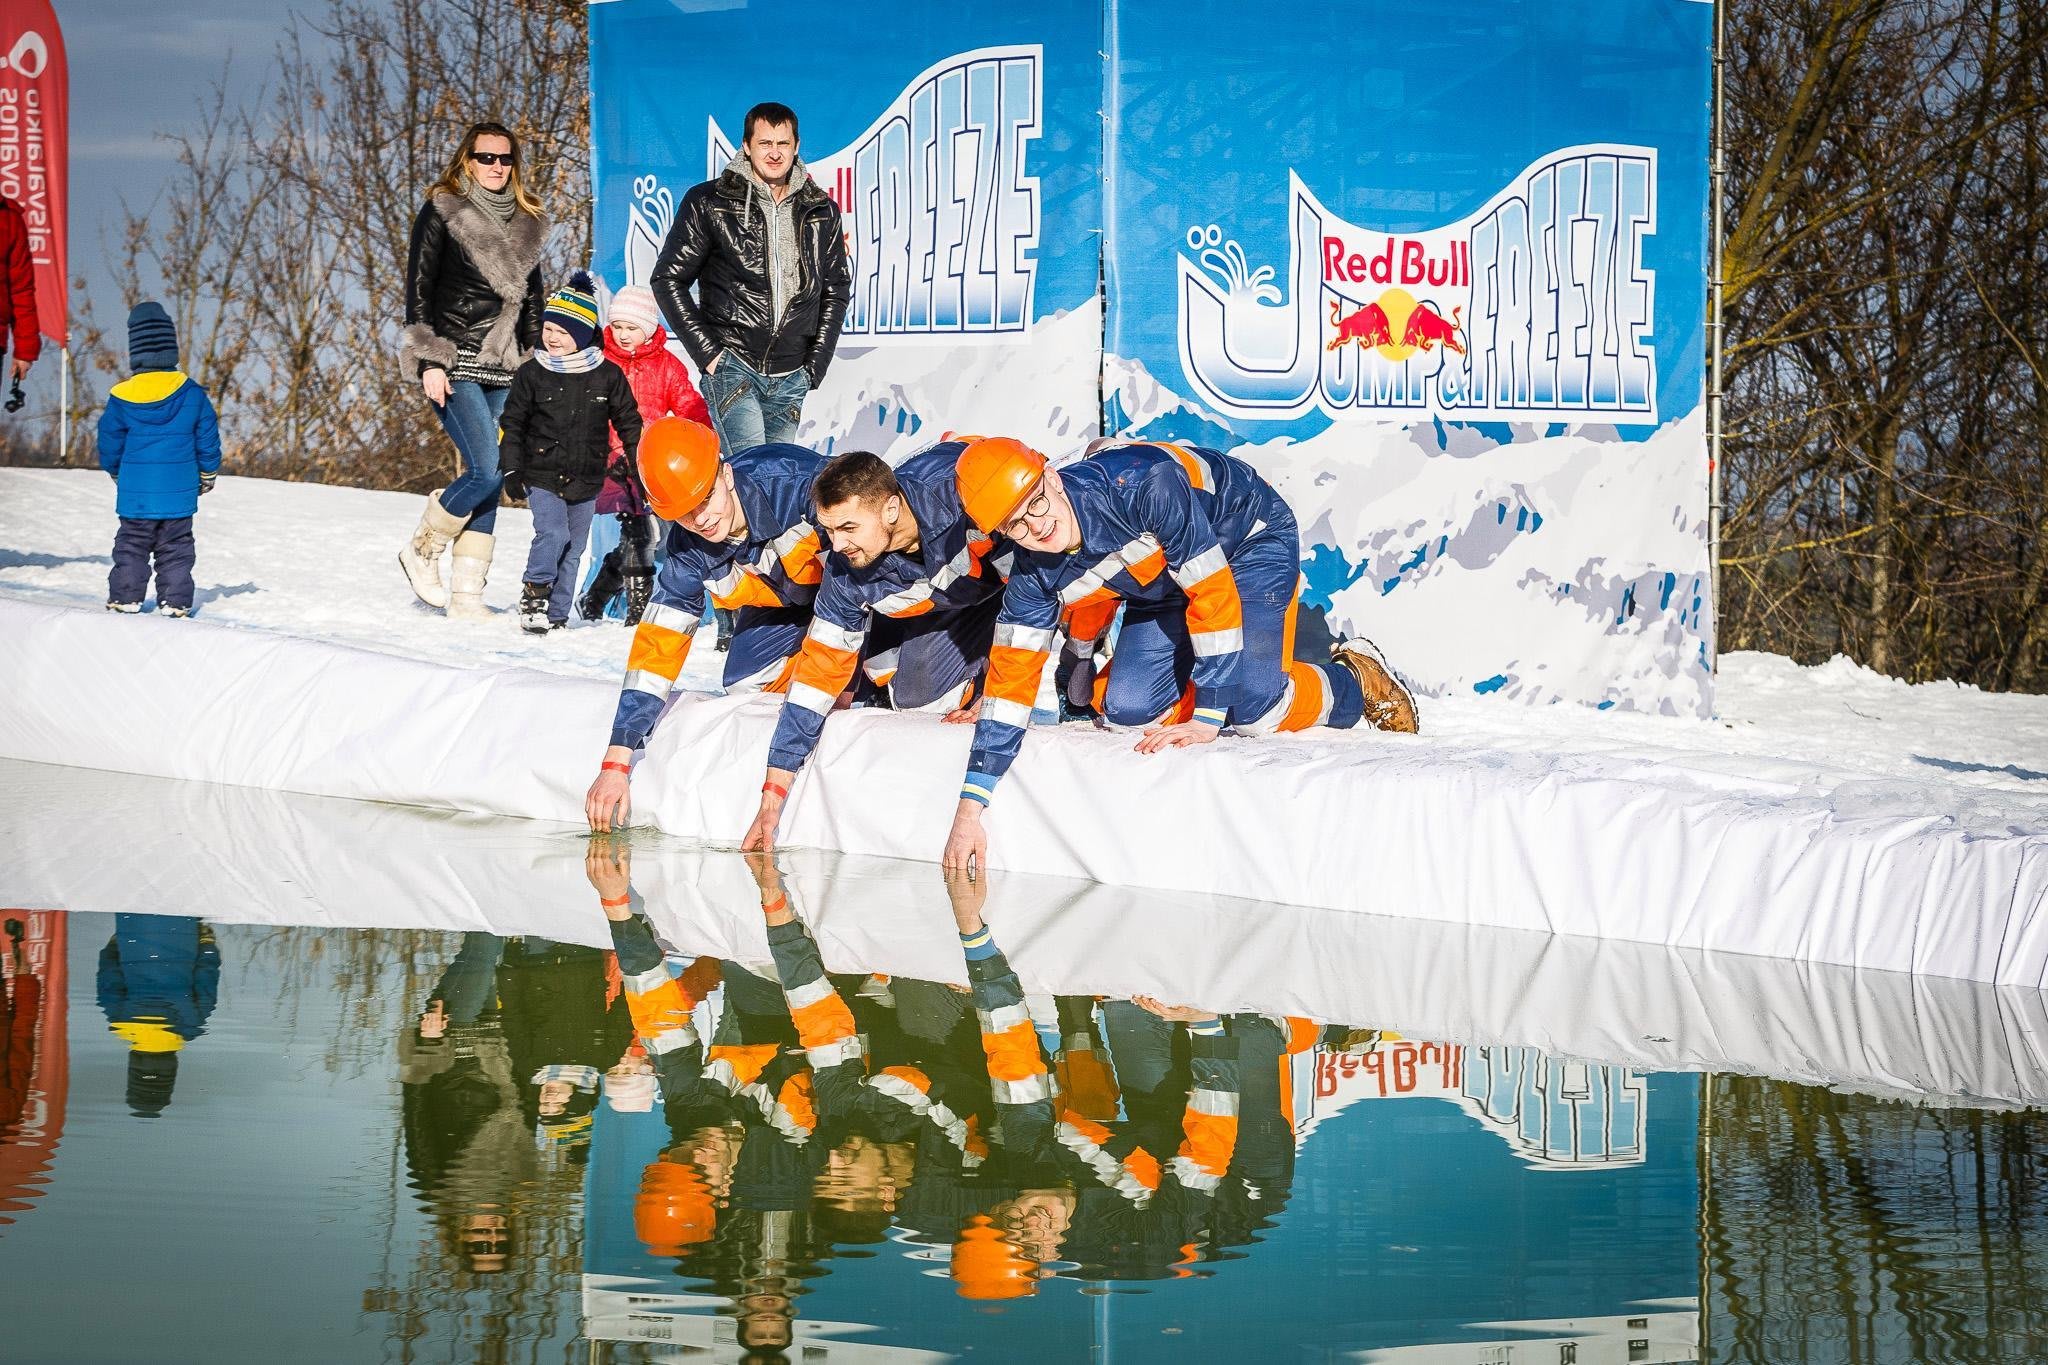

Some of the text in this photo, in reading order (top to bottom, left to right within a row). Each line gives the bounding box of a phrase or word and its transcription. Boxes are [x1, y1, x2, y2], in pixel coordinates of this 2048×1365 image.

[856, 56, 1035, 333] FREEZE
[1323, 236, 1468, 287] Red Bull
